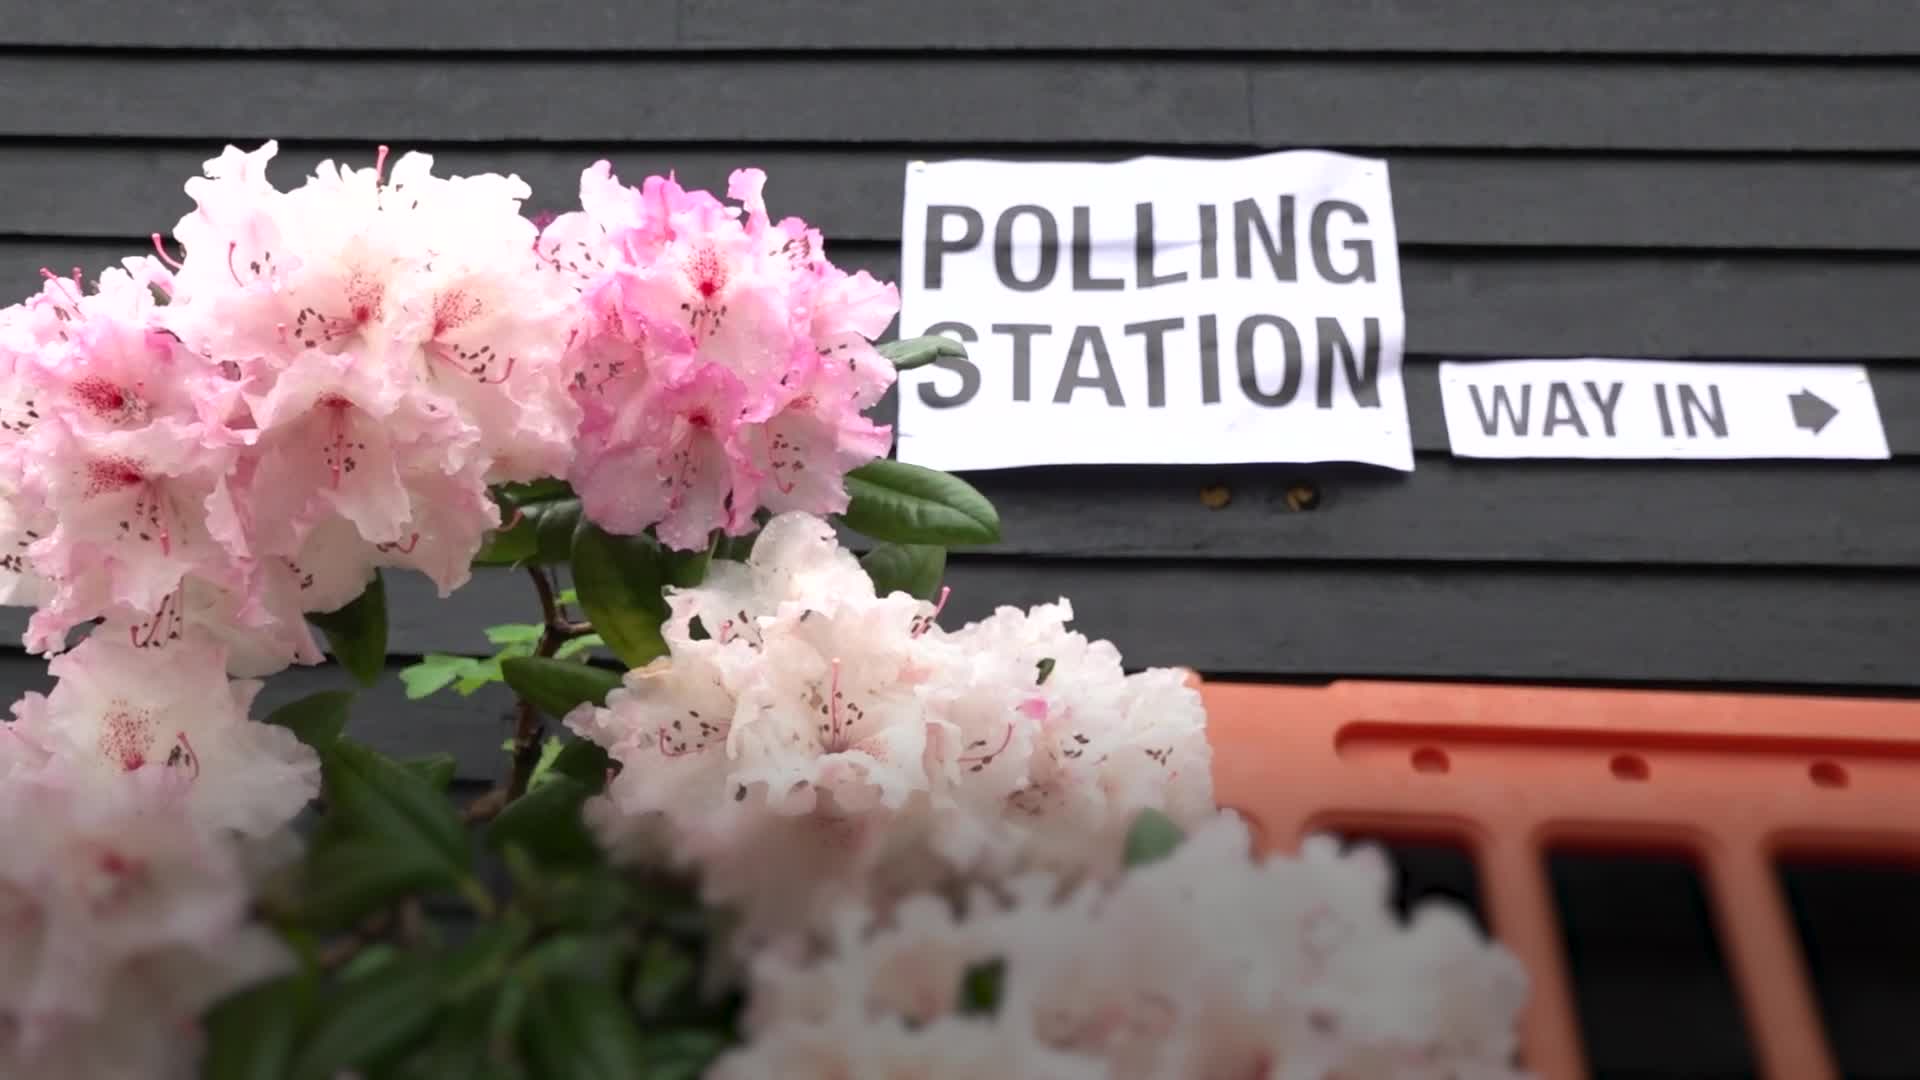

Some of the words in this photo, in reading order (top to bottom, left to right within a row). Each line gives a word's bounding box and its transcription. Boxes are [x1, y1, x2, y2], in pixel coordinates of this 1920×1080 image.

[923, 195, 1377, 292] POLLING
[916, 313, 1382, 411] STATION
[1467, 381, 1623, 438] WAY
[1654, 383, 1729, 438] IN
